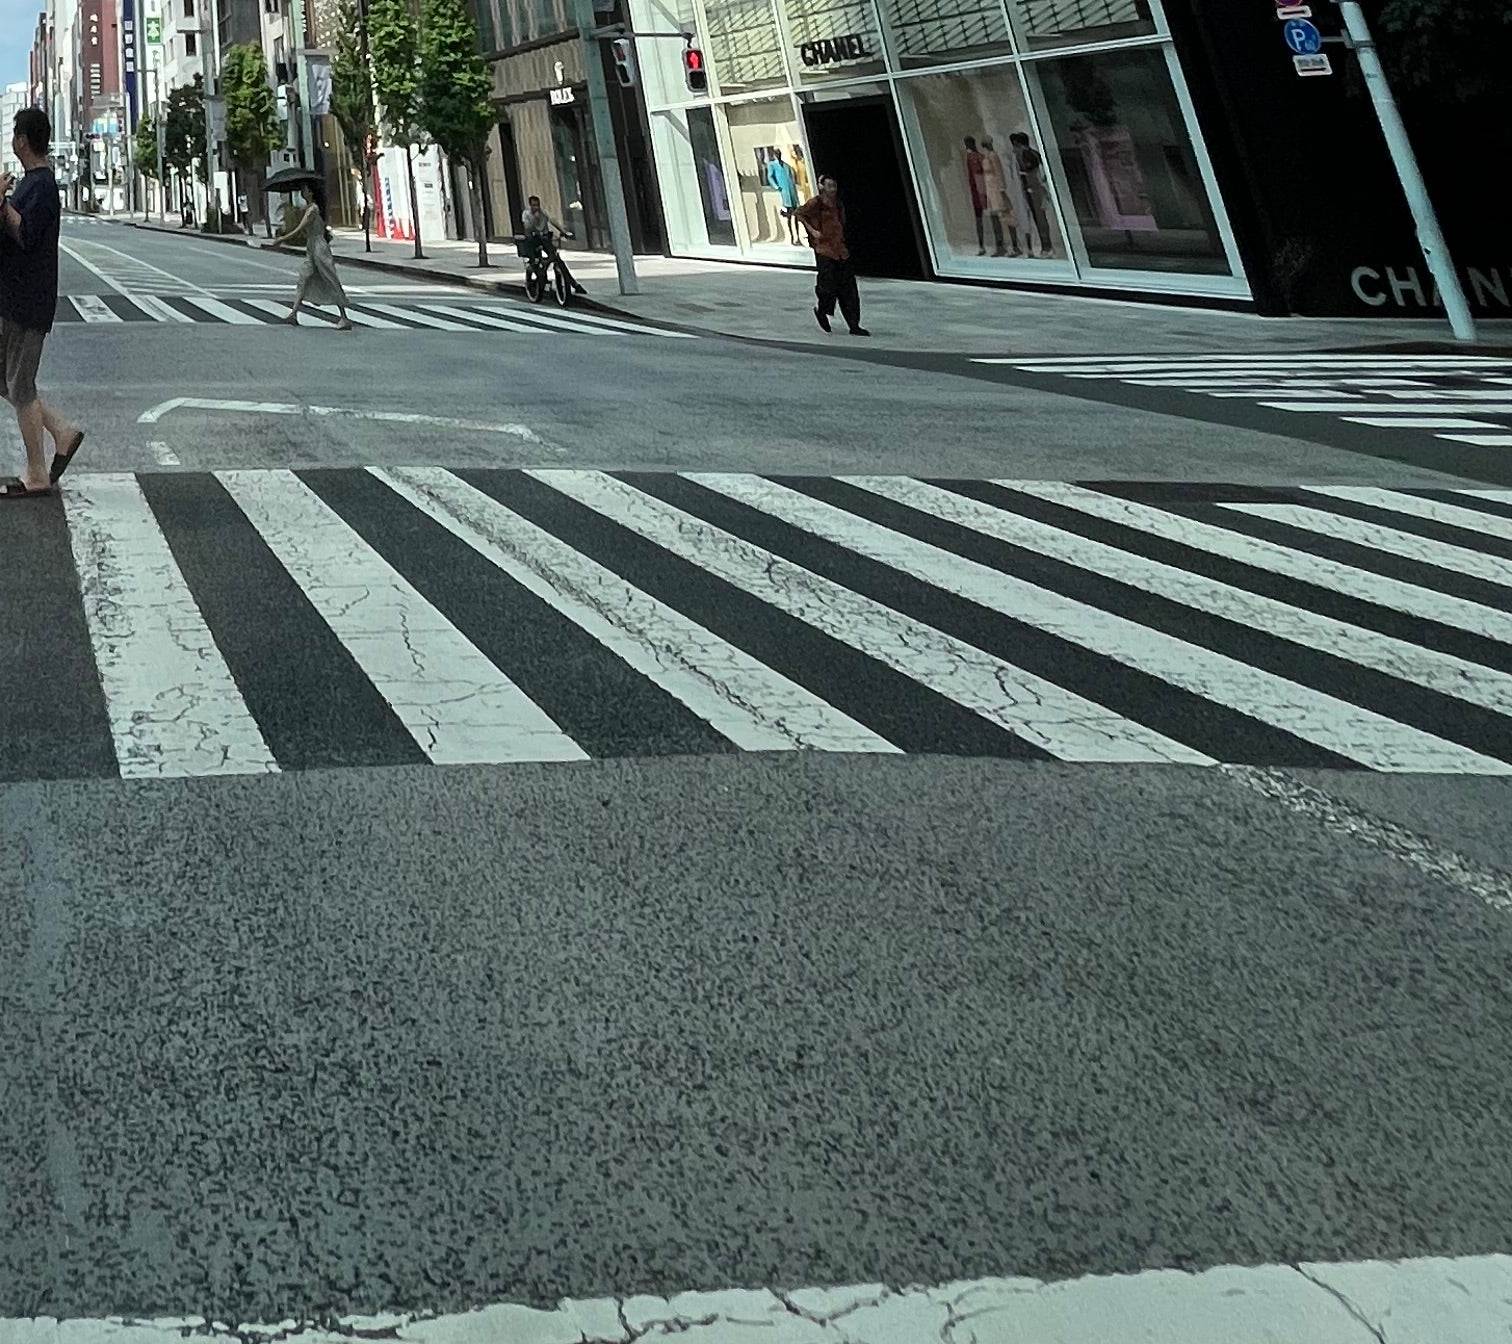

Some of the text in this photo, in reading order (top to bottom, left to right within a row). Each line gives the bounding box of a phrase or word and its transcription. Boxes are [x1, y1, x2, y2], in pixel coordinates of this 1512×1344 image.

[147, 20, 160, 40] 本
[801, 34, 877, 66] CHANEL
[1351, 265, 1512, 307] CHN
